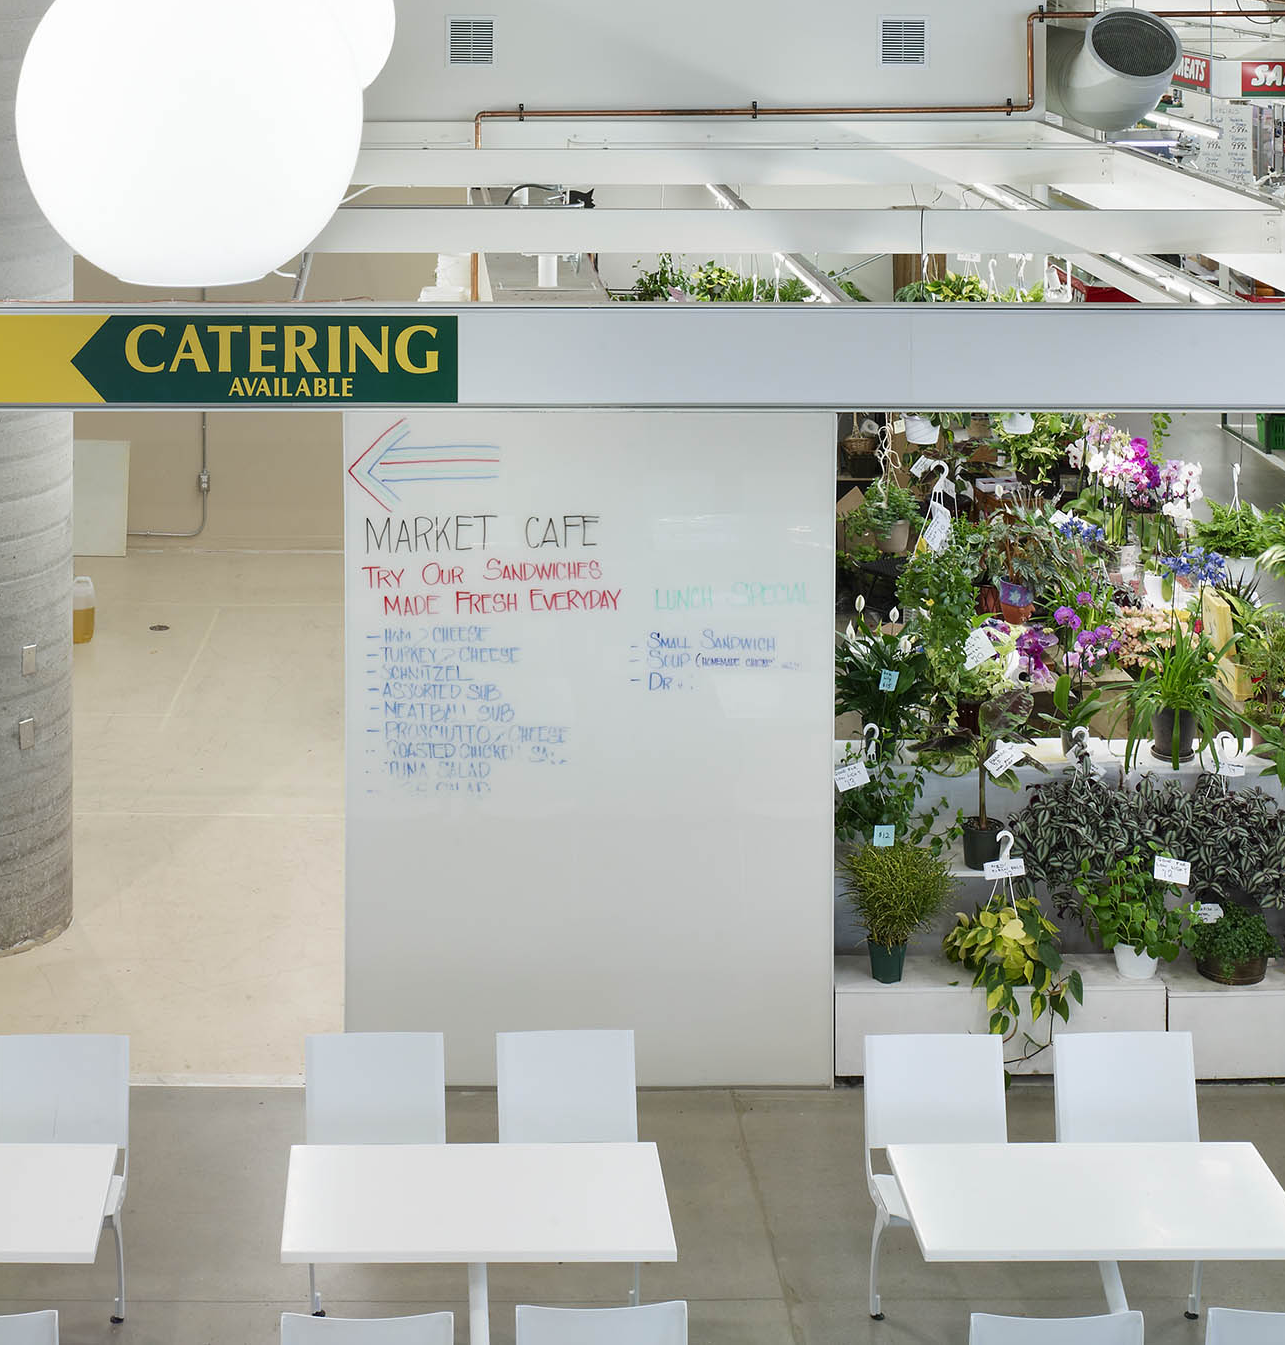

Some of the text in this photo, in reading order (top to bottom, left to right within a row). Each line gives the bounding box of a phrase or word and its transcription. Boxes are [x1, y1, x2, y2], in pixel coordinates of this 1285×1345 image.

[124, 323, 439, 375] CATERING
[228, 377, 354, 398] AVAILABLE
[365, 515, 602, 553] MARKET CAFE
[362, 558, 603, 589] TRY OUR SANDWICHES
[384, 588, 623, 617] MADE FRESH EVERYDAY
[655, 585, 713, 611] LUNCH
[647, 628, 776, 652] SMALL SANDWICH
[647, 650, 691, 670] SOUP
[466, 683, 503, 701] SUB
[476, 703, 516, 723] SUB
